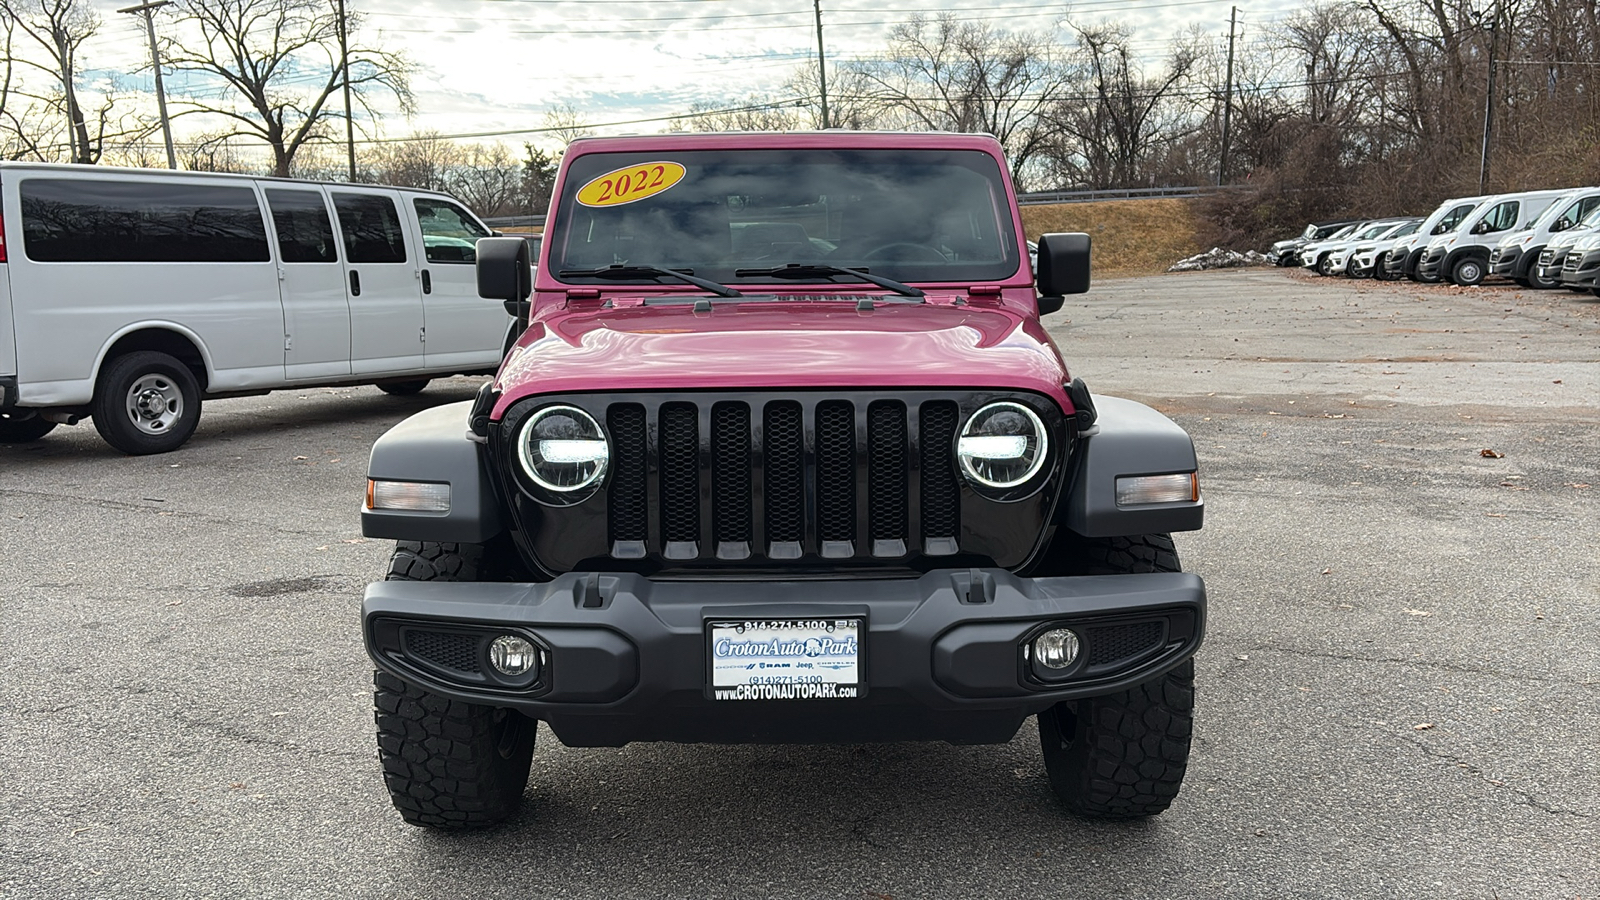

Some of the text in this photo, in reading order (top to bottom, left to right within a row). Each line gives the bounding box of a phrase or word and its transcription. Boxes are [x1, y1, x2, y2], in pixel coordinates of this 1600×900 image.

[597, 165, 665, 203] 2022
[744, 621, 827, 631] 914-271-5100
[715, 637, 857, 657] CrotonAuto Park
[749, 675, 823, 684] (914)271-5100
